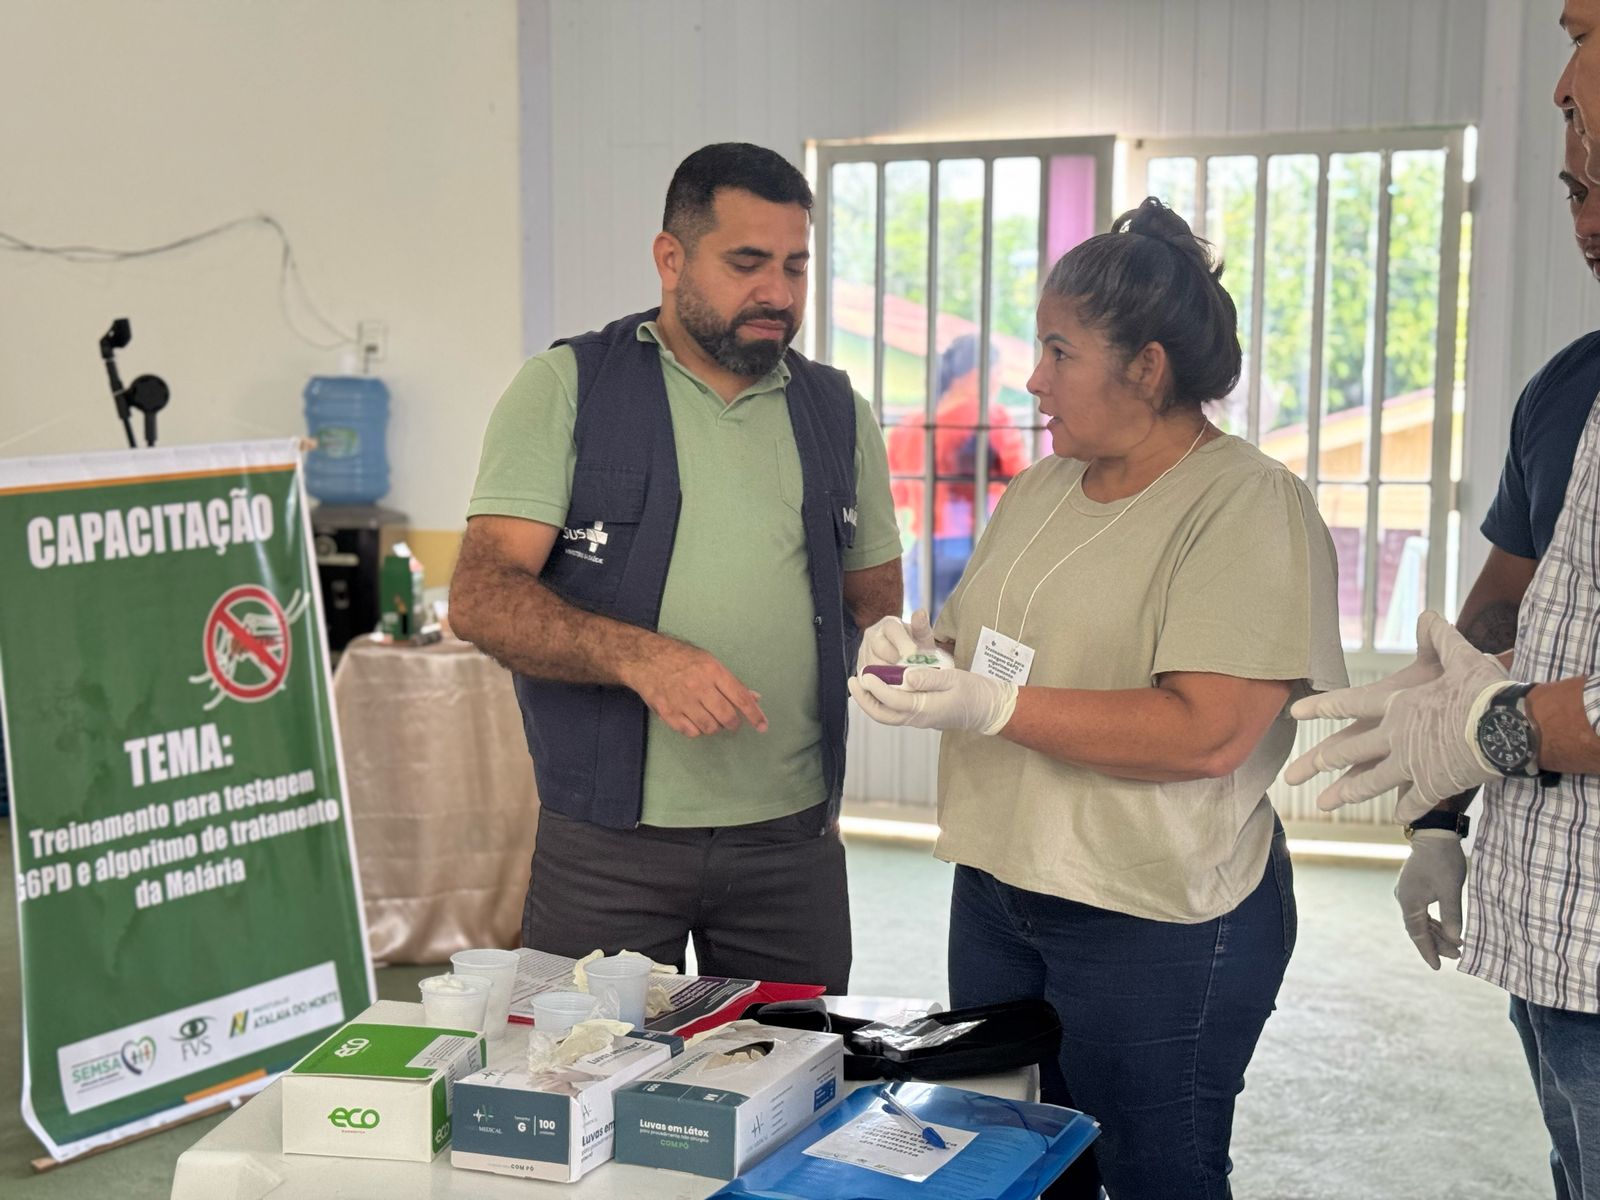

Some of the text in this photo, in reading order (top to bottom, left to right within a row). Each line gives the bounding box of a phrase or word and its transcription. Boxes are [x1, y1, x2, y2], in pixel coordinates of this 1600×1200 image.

[27, 487, 274, 570] CAPACITAÇÃO
[562, 527, 587, 540] SUS
[124, 723, 234, 788] TEMA:
[30, 769, 315, 859] Treinamento para testagem
[77, 866, 91, 887] e
[95, 833, 198, 882] algoritmo
[201, 825, 228, 854] de
[231, 798, 340, 846] tratamento
[136, 858, 247, 909] da Malária
[180, 1035, 213, 1062] FVS
[72, 1056, 122, 1085] SEMSA
[327, 1107, 381, 1130] eco
[478, 1125, 503, 1135] MEDICAL
[517, 1121, 528, 1133] G
[539, 1119, 556, 1130] 100
[640, 1119, 710, 1138] Luvas em Látex
[434, 1121, 450, 1144] eco
[582, 1127, 604, 1148] Luvas
[660, 1139, 679, 1149] COM
[510, 1163, 525, 1171] COM
